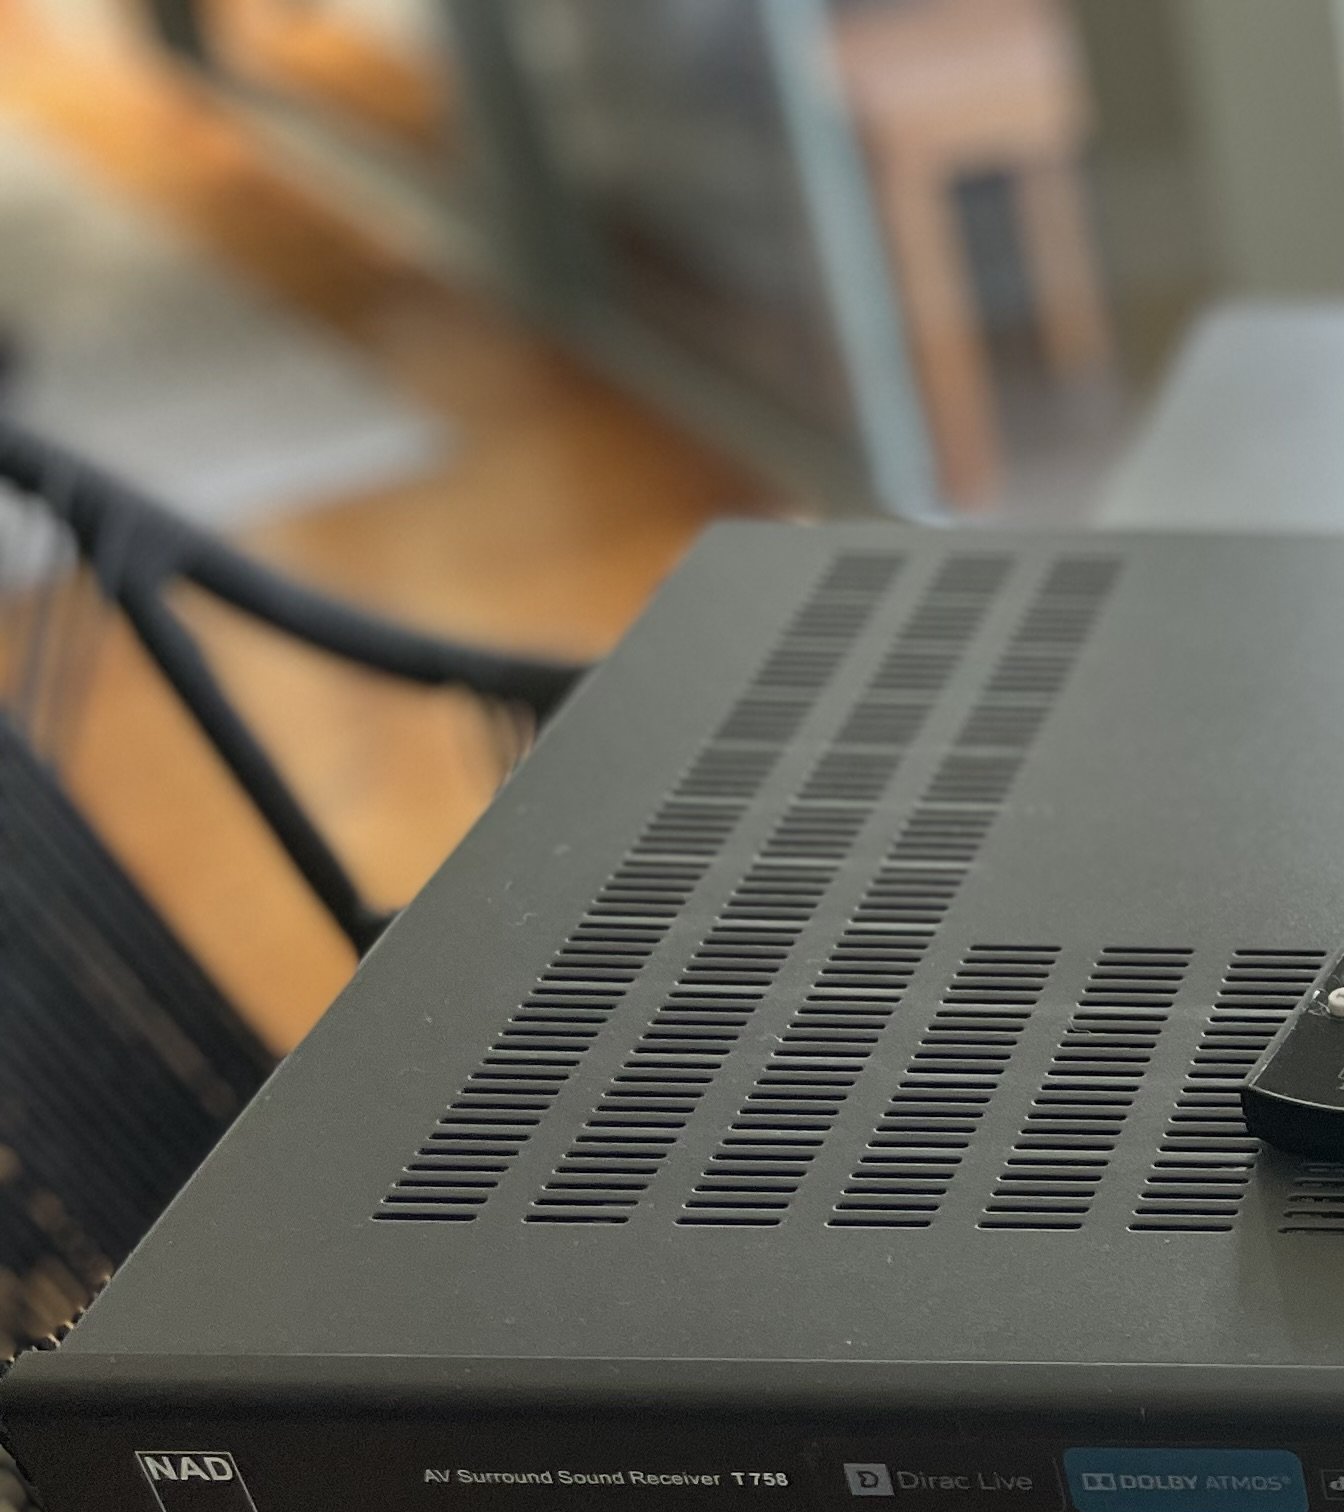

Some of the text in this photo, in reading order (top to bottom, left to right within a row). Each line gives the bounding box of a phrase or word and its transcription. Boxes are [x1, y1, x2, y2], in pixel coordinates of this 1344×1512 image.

[144, 1456, 234, 1481] NAD
[424, 1469, 451, 1484] AV
[457, 1469, 553, 1484] Surround
[558, 1470, 625, 1486] Sound
[628, 1470, 721, 1486] Receiver
[896, 1470, 971, 1490] Dirac
[977, 1470, 1034, 1491] Live
[1119, 1474, 1198, 1491] DOLBY
